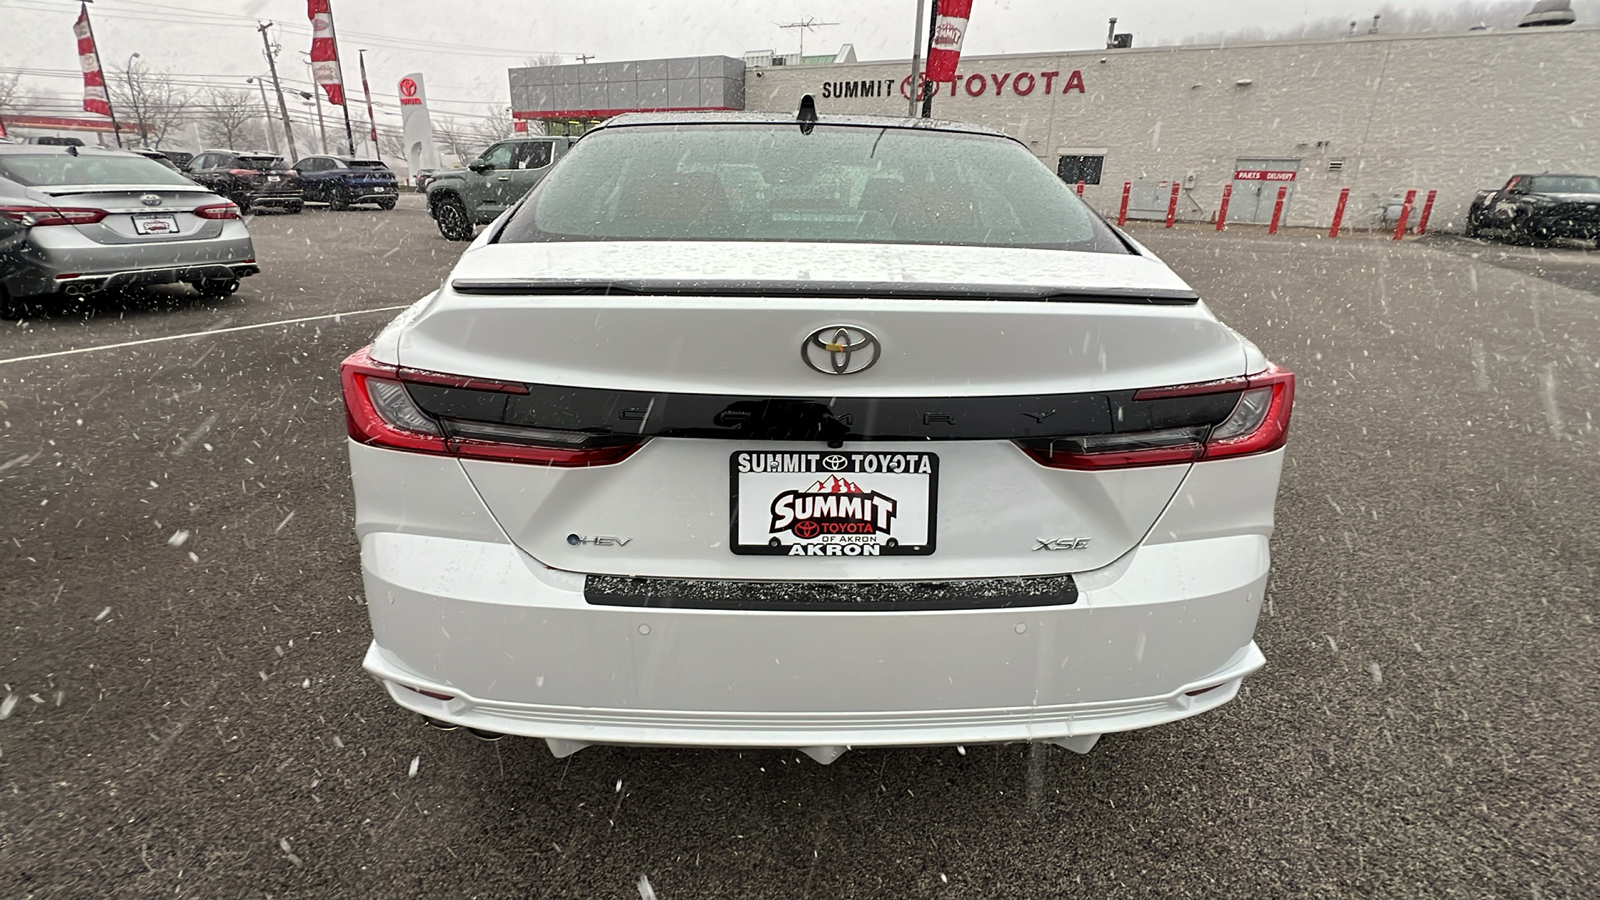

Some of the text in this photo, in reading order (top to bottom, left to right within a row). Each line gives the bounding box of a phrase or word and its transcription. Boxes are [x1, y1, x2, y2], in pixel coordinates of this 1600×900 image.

[822, 70, 1086, 99] SUMMIT TOYOTA
[1238, 171, 1293, 181] PARTS DELIVERY
[738, 453, 932, 474] SUMMIT TOYOTA
[774, 494, 893, 529] SUMMIT
[821, 522, 874, 534] TOYOTA
[821, 535, 877, 543] OF AKRON
[1031, 536, 1092, 551] XSE
[788, 543, 880, 556] AKRON
